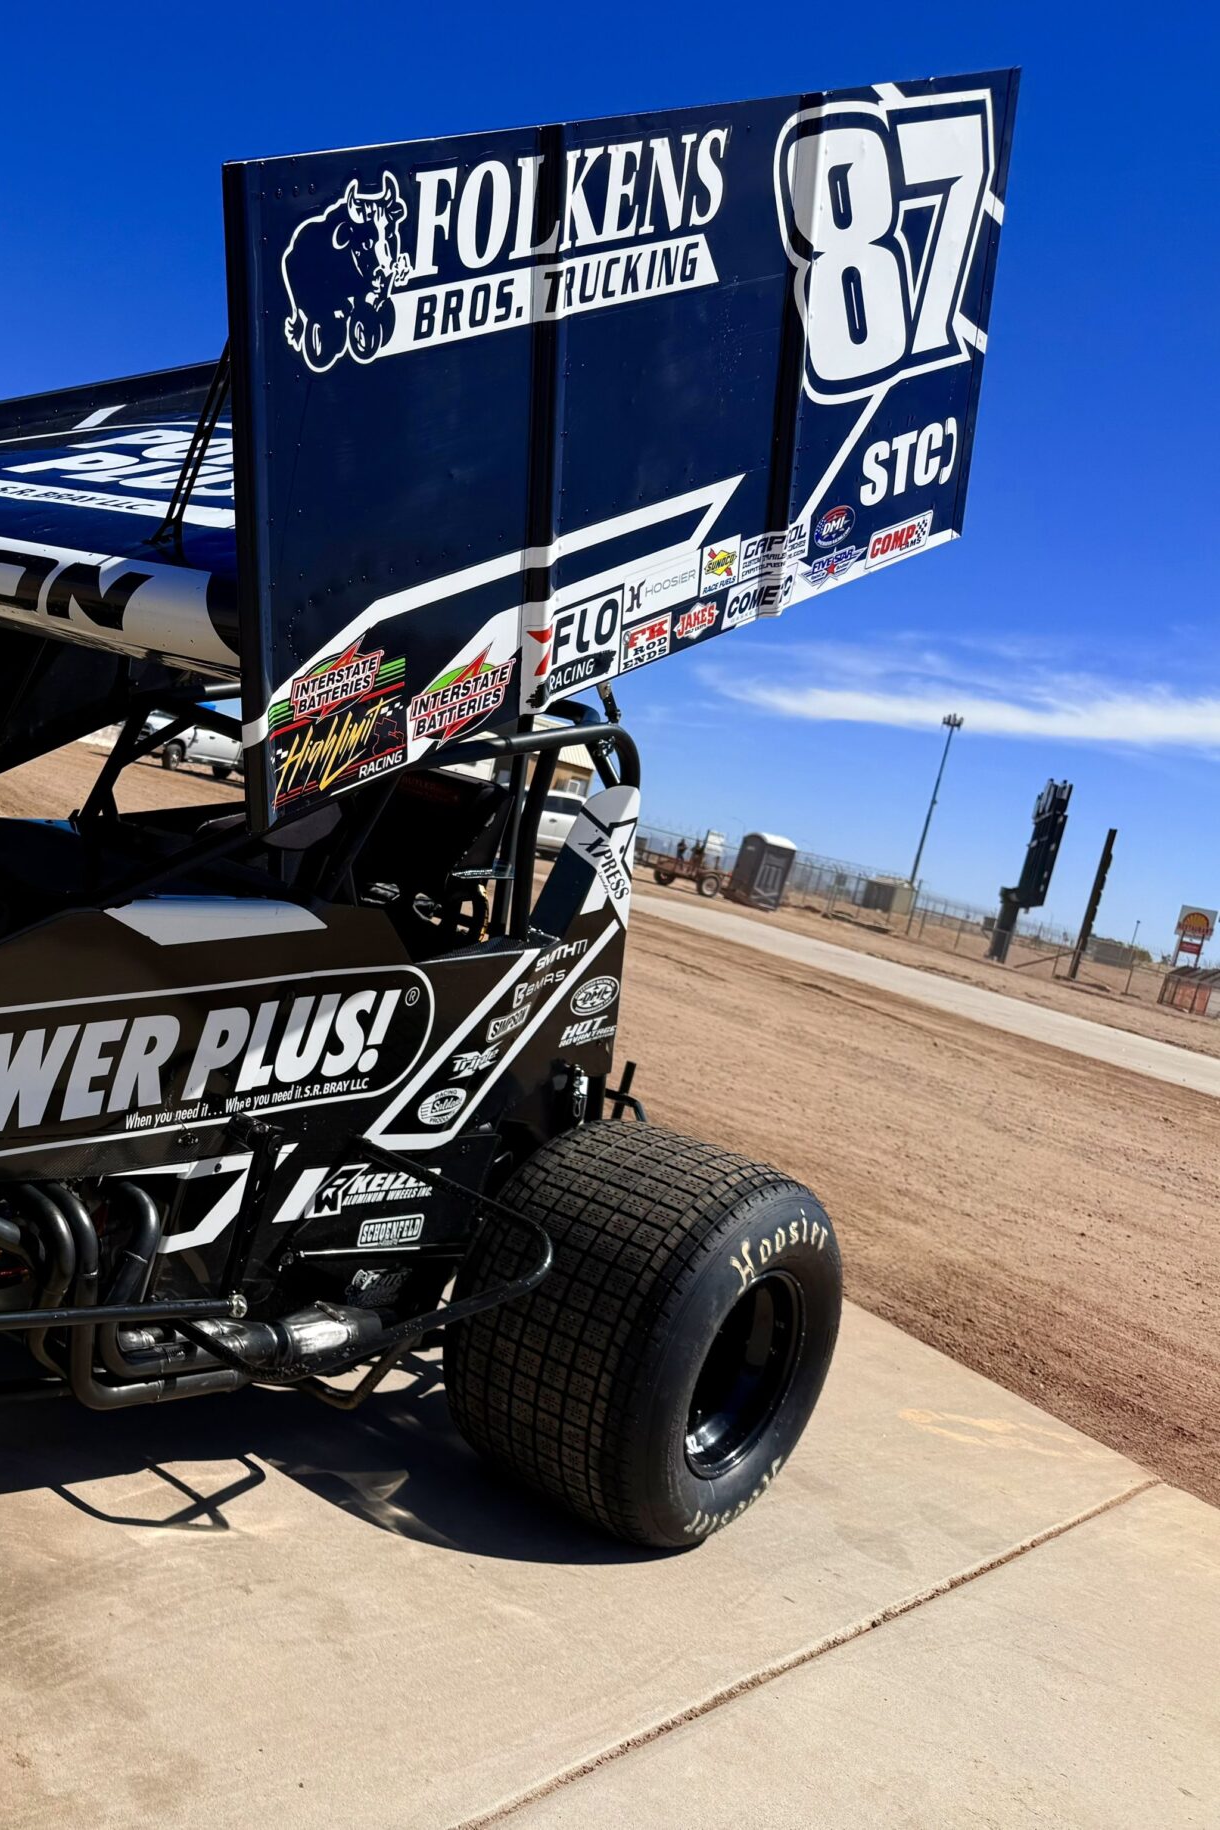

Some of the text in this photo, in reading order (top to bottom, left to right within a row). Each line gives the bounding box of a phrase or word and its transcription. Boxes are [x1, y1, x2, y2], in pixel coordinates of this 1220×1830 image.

[408, 127, 729, 280] FOLKENS
[784, 110, 988, 384] 87
[413, 241, 700, 341] BROS. TRUCKING
[38, 490, 100, 505] BRAY
[95, 499, 156, 511] LLC
[869, 523, 917, 560] COMP
[705, 552, 737, 574] SUNOCO
[812, 558, 833, 574] FIVE
[644, 568, 697, 598] HOOSIER
[702, 575, 737, 595] RACE FUELS
[551, 597, 619, 666] FLO
[627, 619, 668, 649] FK
[677, 602, 716, 638] JAKES
[622, 645, 668, 671] ENDS
[633, 636, 668, 656] ROD
[293, 658, 378, 700] INTERSTATE
[411, 665, 511, 718] INTERSTATE
[548, 657, 595, 692] RACING
[296, 674, 372, 714] BATTERIES
[415, 687, 503, 738] BATTERIES
[357, 749, 404, 779] RACING
[578, 836, 630, 900] XPRESS
[179, 988, 402, 1101] PLUS!
[561, 1014, 609, 1041] HOT
[126, 1112, 152, 1130] When
[154, 1110, 173, 1129] you
[175, 1102, 200, 1120] need
[253, 1093, 270, 1110] you
[271, 1084, 294, 1103] need
[322, 1080, 349, 1095] BRAY
[350, 1078, 370, 1090] LLC
[341, 1190, 386, 1207] ALUMINUM
[386, 1187, 419, 1201] WHEELS
[360, 1218, 421, 1243] SCHOENFELD
[730, 1208, 829, 1296] Hoosier
